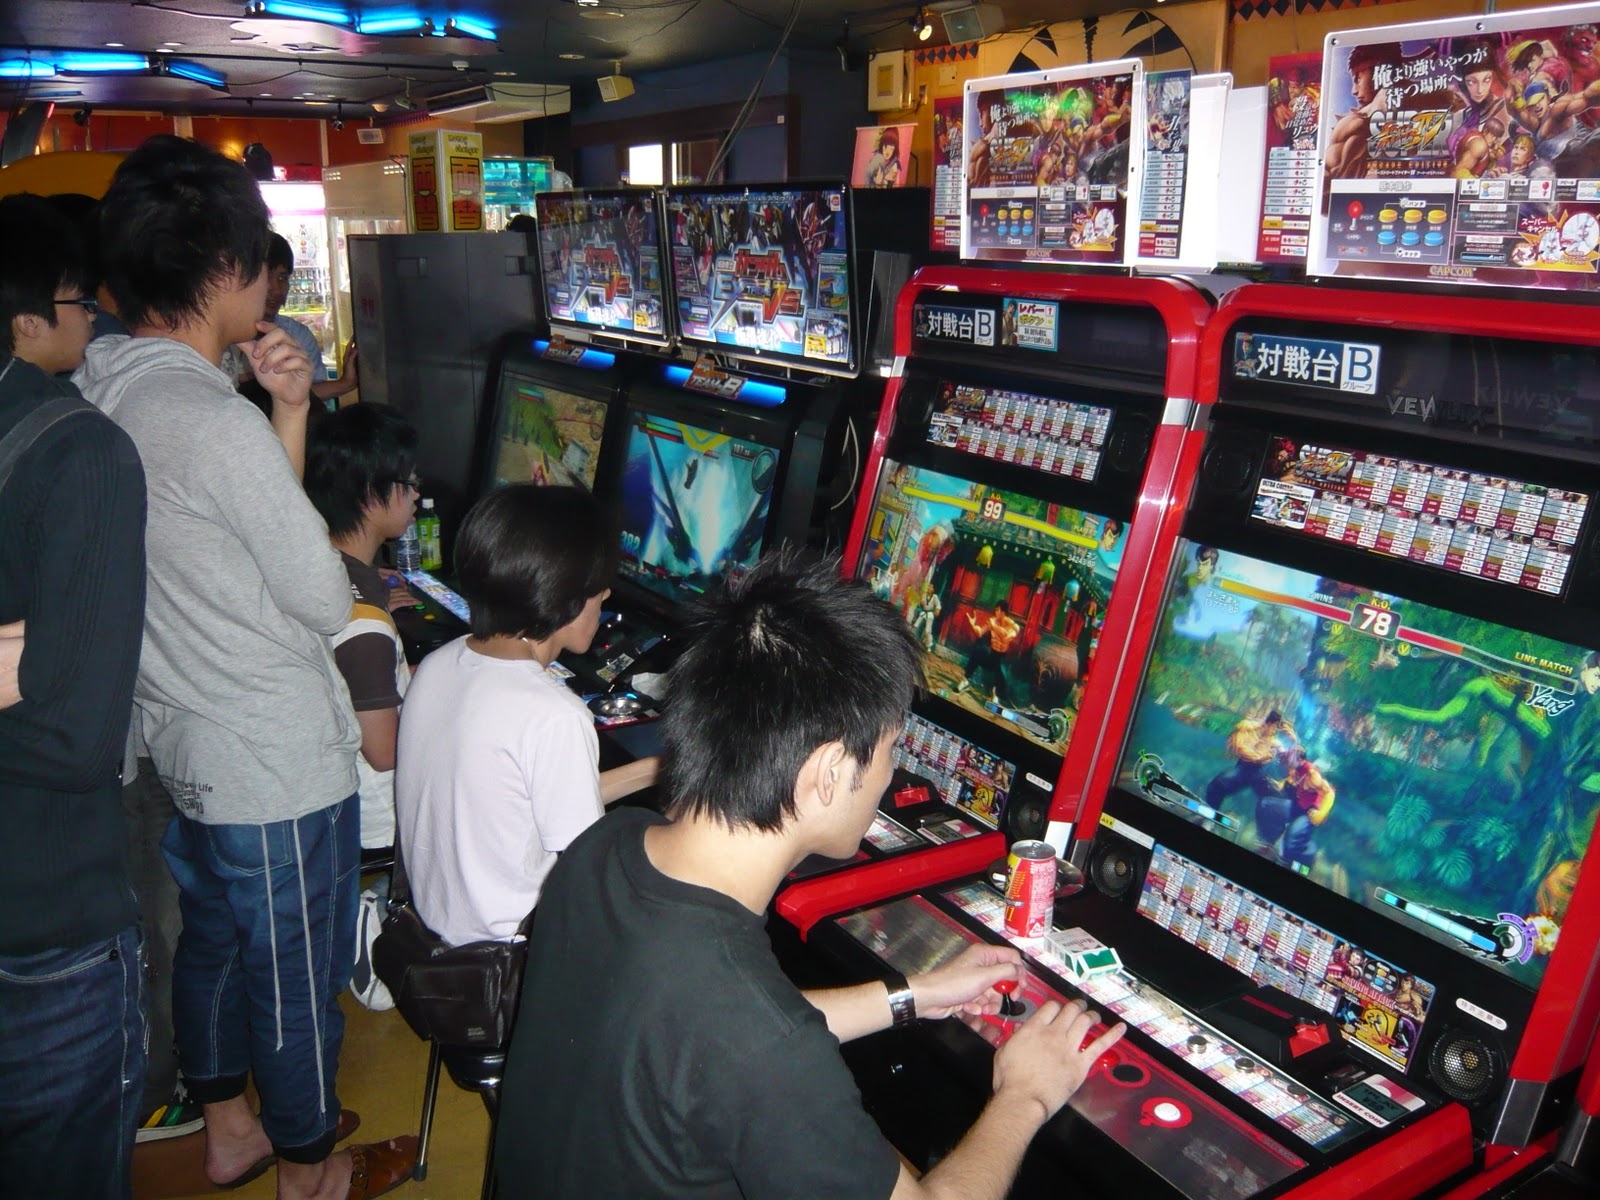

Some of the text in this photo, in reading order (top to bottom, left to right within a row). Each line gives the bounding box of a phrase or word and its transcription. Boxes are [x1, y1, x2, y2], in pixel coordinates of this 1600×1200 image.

[1372, 46, 1488, 90] 俺より強いやつが
[1386, 74, 1462, 110] 待つ場所へ
[1521, 217, 1548, 226] スーパー
[1527, 225, 1559, 233] キャンセル
[1429, 266, 1474, 278] CAPCOM
[1019, 303, 1045, 315] レバー
[928, 311, 991, 339] 対戦台 B
[1019, 314, 1044, 326] ボタン
[1256, 342, 1374, 384] 対戦台 B
[1342, 380, 1374, 393] グループ
[983, 500, 1003, 520] 99
[1314, 592, 1334, 604] WINS
[1371, 598, 1391, 610] K.O.
[1359, 607, 1393, 636] 78
[1515, 651, 1574, 675] LINK MATCH
[1525, 682, 1575, 717] Yang
[1337, 1094, 1385, 1126] INSERT COIN
